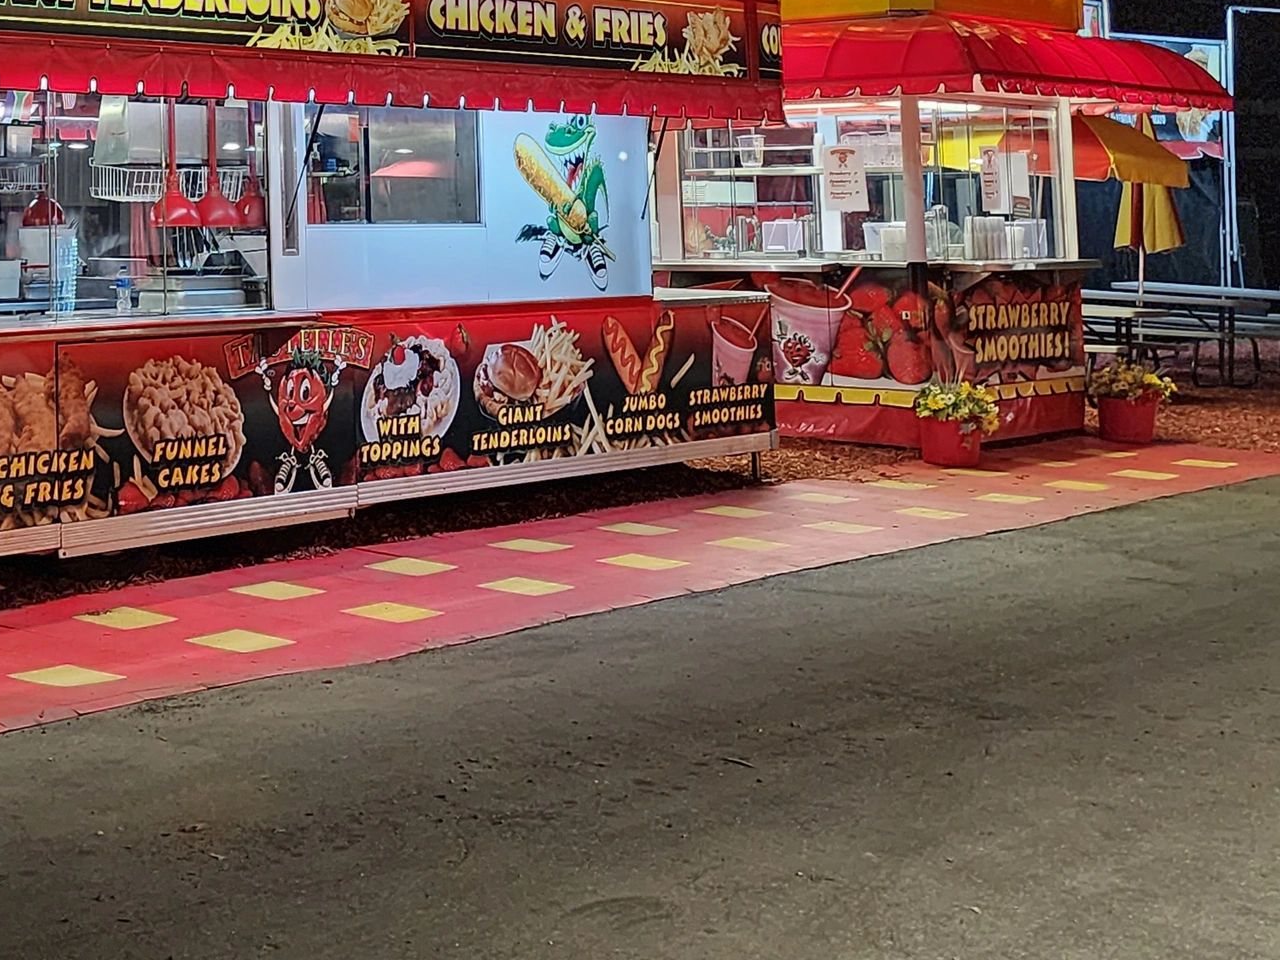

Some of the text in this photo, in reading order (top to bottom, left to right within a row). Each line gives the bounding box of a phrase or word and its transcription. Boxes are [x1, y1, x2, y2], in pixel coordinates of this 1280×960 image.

[566, 6, 587, 41] &
[594, 7, 667, 48] FRIES
[968, 302, 1070, 331] STRAWBERRY
[975, 332, 1071, 364] SMOOTHIES!
[622, 393, 666, 413] JUMBO
[689, 384, 768, 406] STRAWBERRY
[379, 416, 420, 437] WITH
[498, 405, 543, 425] GIANT
[606, 412, 680, 435] CORN DOGS
[694, 404, 763, 427] SMOOTHIES
[152, 438, 227, 462] FUNNEL
[472, 424, 570, 451] TENDERLOINS
[361, 437, 441, 464] TOPPINGS
[158, 461, 222, 488] CAKES
[0, 477, 85, 507] & FRIES
